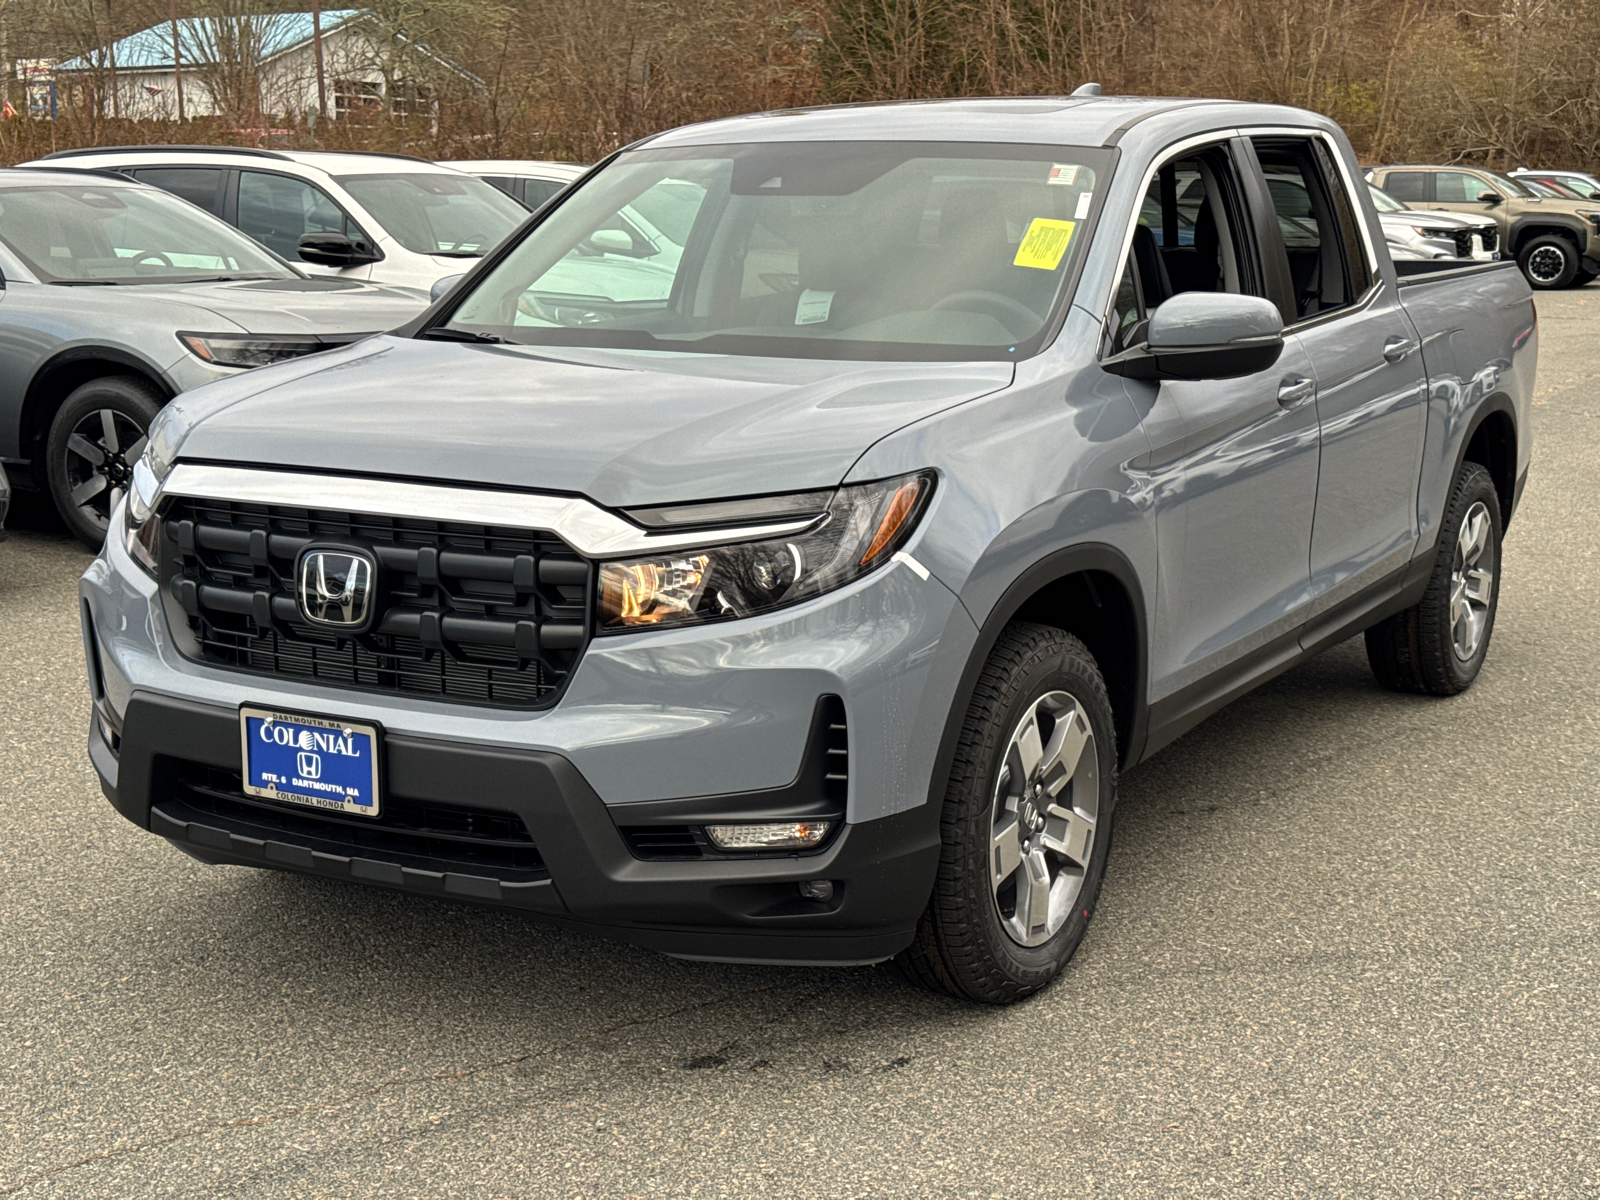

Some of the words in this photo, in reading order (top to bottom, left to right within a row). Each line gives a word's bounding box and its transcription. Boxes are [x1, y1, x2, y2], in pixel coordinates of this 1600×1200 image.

[272, 713, 327, 728] DARTMOUTH,
[328, 721, 342, 729] MA
[260, 724, 360, 757] COLONIAL
[262, 772, 280, 783] RTE.
[281, 776, 287, 784] 6
[292, 778, 345, 795] DARTMOUTH,
[346, 787, 360, 797] MA
[276, 791, 315, 805] COLONIAL
[316, 798, 345, 810] HONDA
